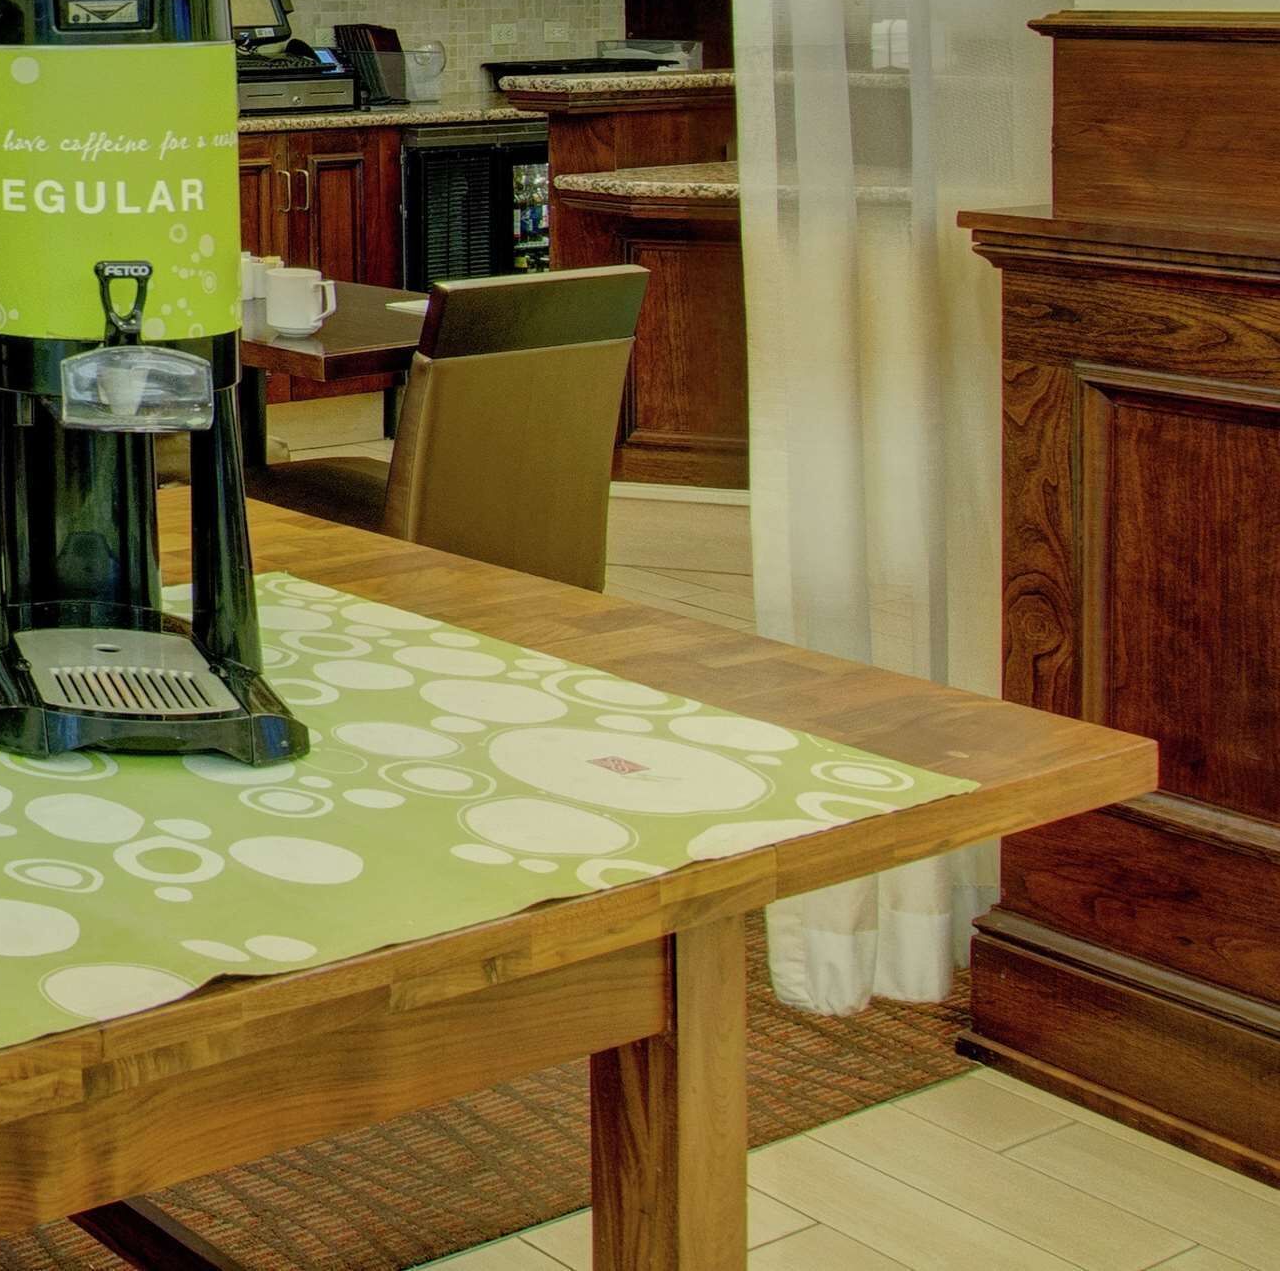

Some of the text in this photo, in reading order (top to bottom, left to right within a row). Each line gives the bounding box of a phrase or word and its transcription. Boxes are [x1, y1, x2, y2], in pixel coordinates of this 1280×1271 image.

[3, 129, 50, 152] have
[60, 132, 151, 162] caffeine
[159, 130, 190, 160] for
[104, 265, 150, 276] FETCO
